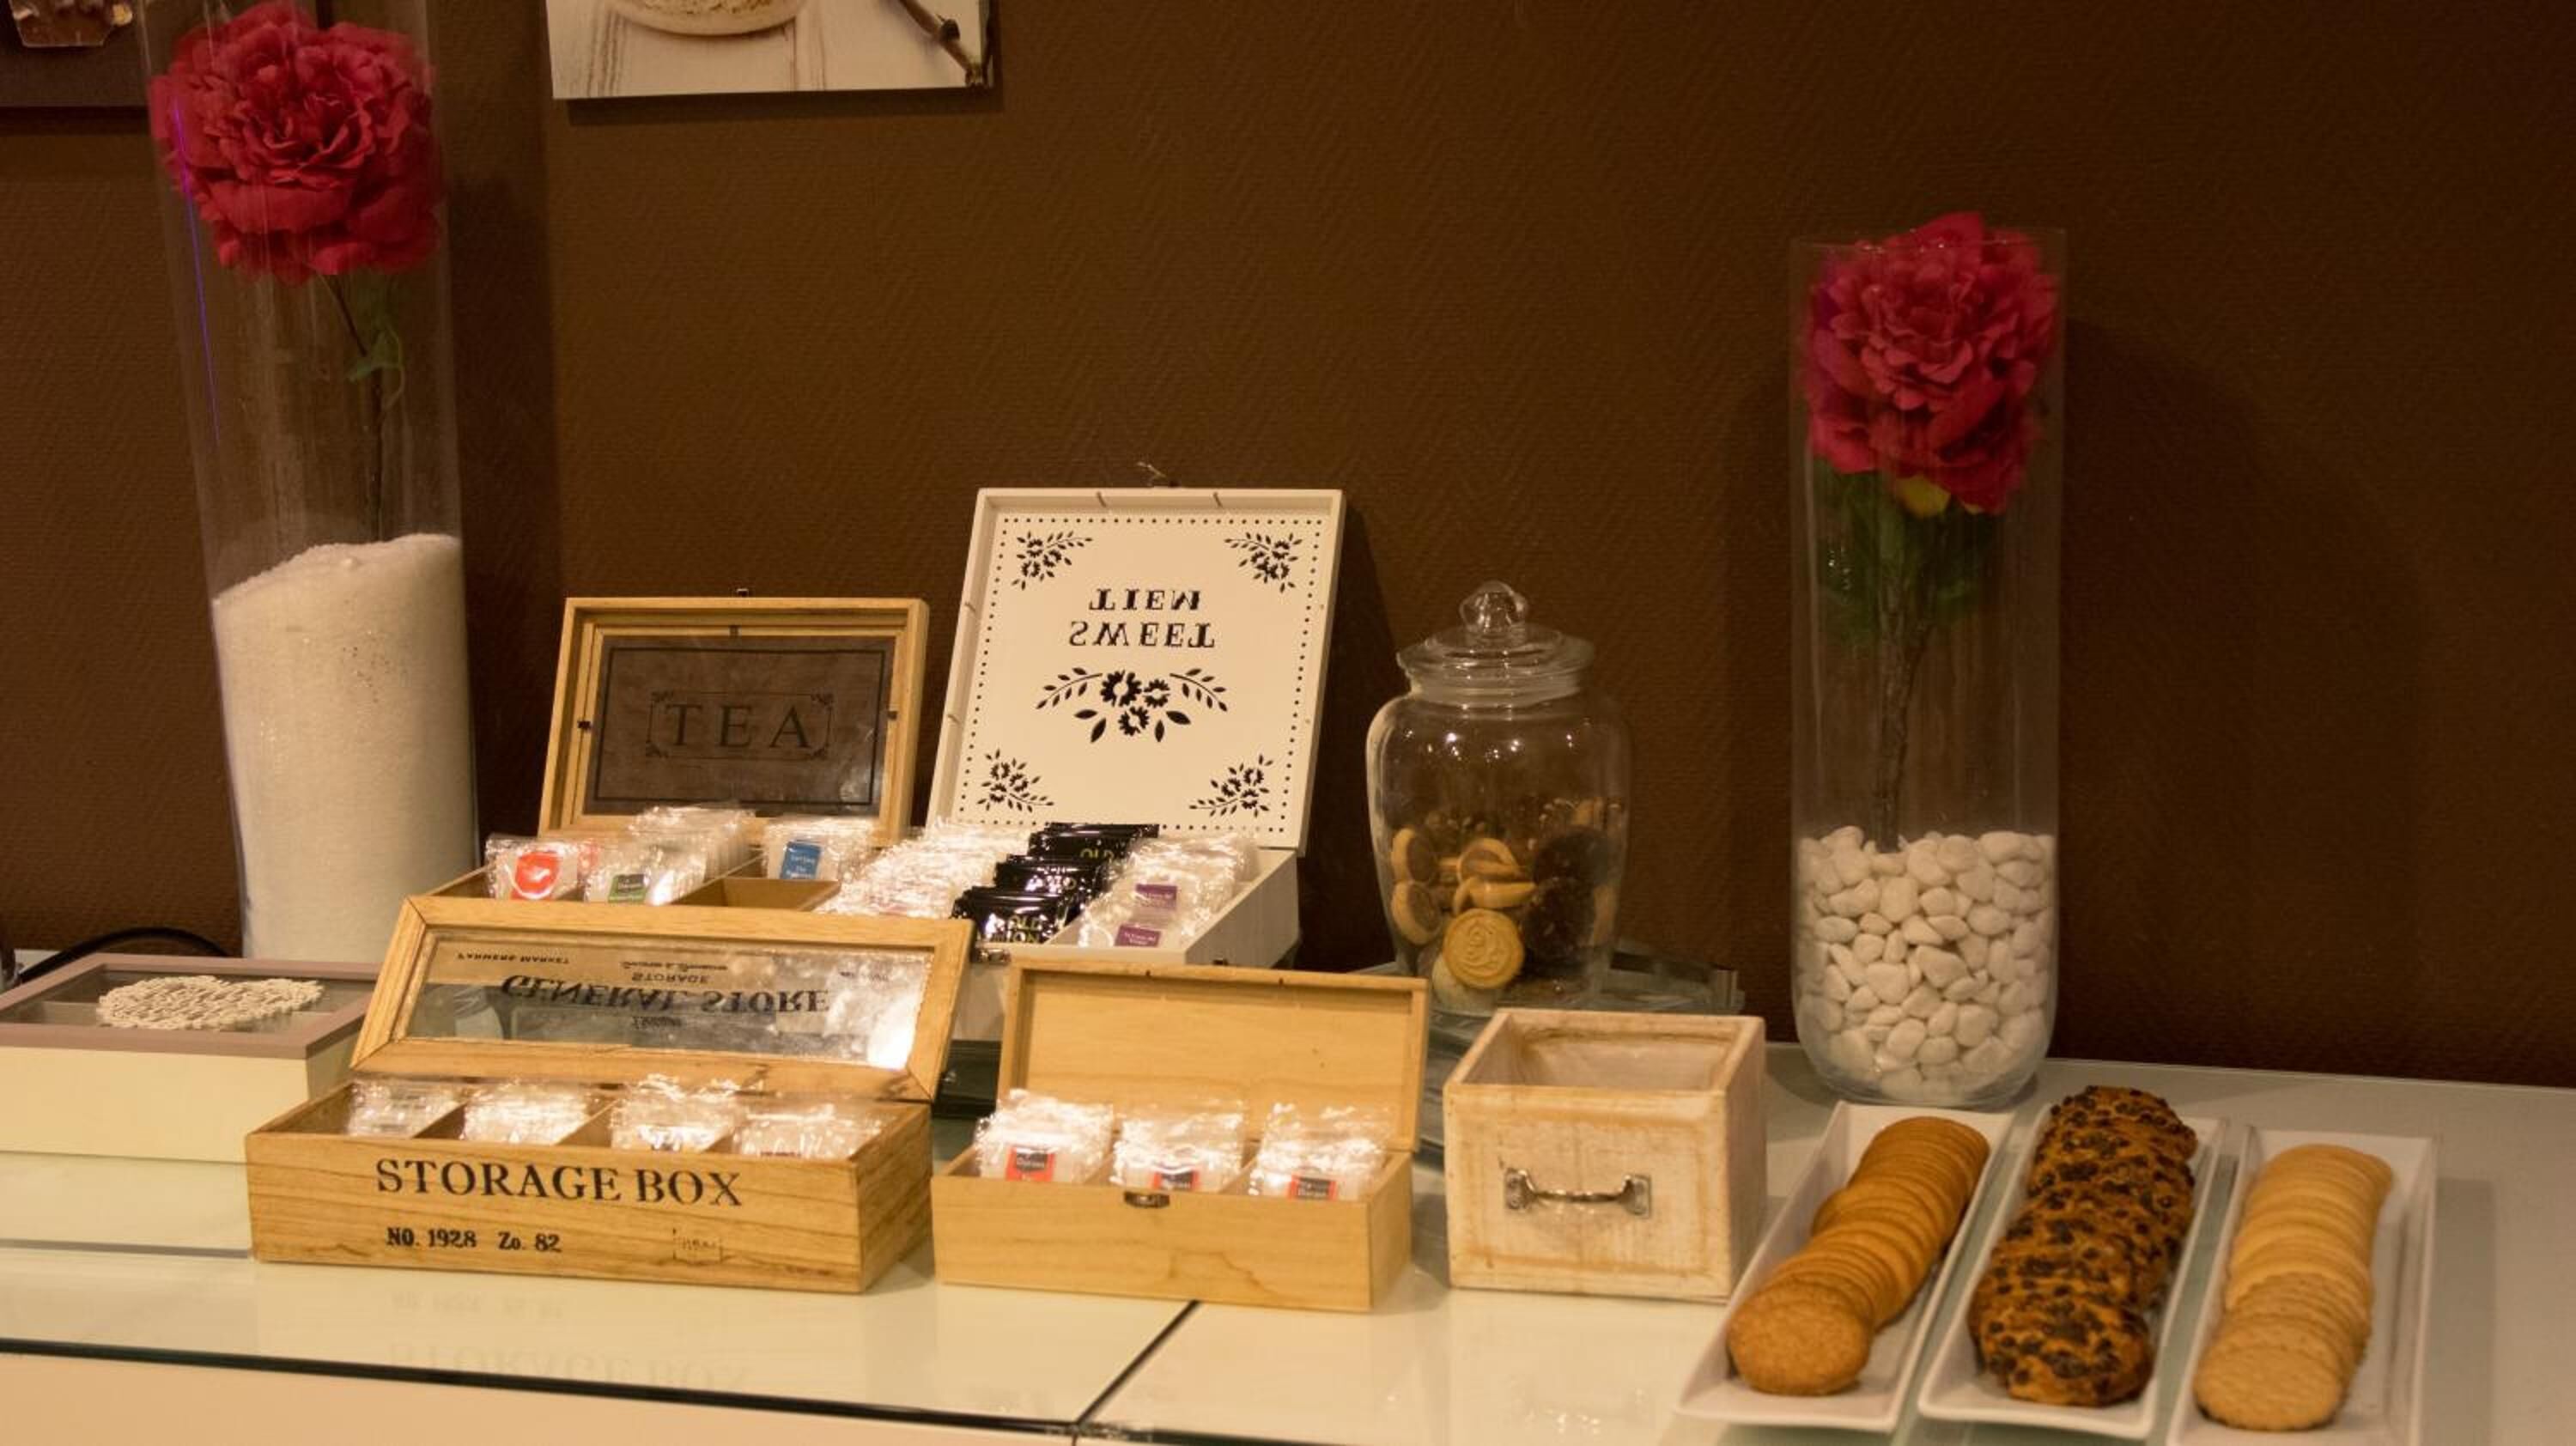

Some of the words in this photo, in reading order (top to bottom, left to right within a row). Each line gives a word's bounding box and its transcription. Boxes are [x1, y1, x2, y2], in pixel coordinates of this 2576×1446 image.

[665, 702, 812, 749] TEA
[375, 1158, 623, 1202] STORAGE
[634, 1168, 743, 1206] BOX
[427, 1228, 478, 1249] 1928
[535, 1232, 563, 1254] 82
